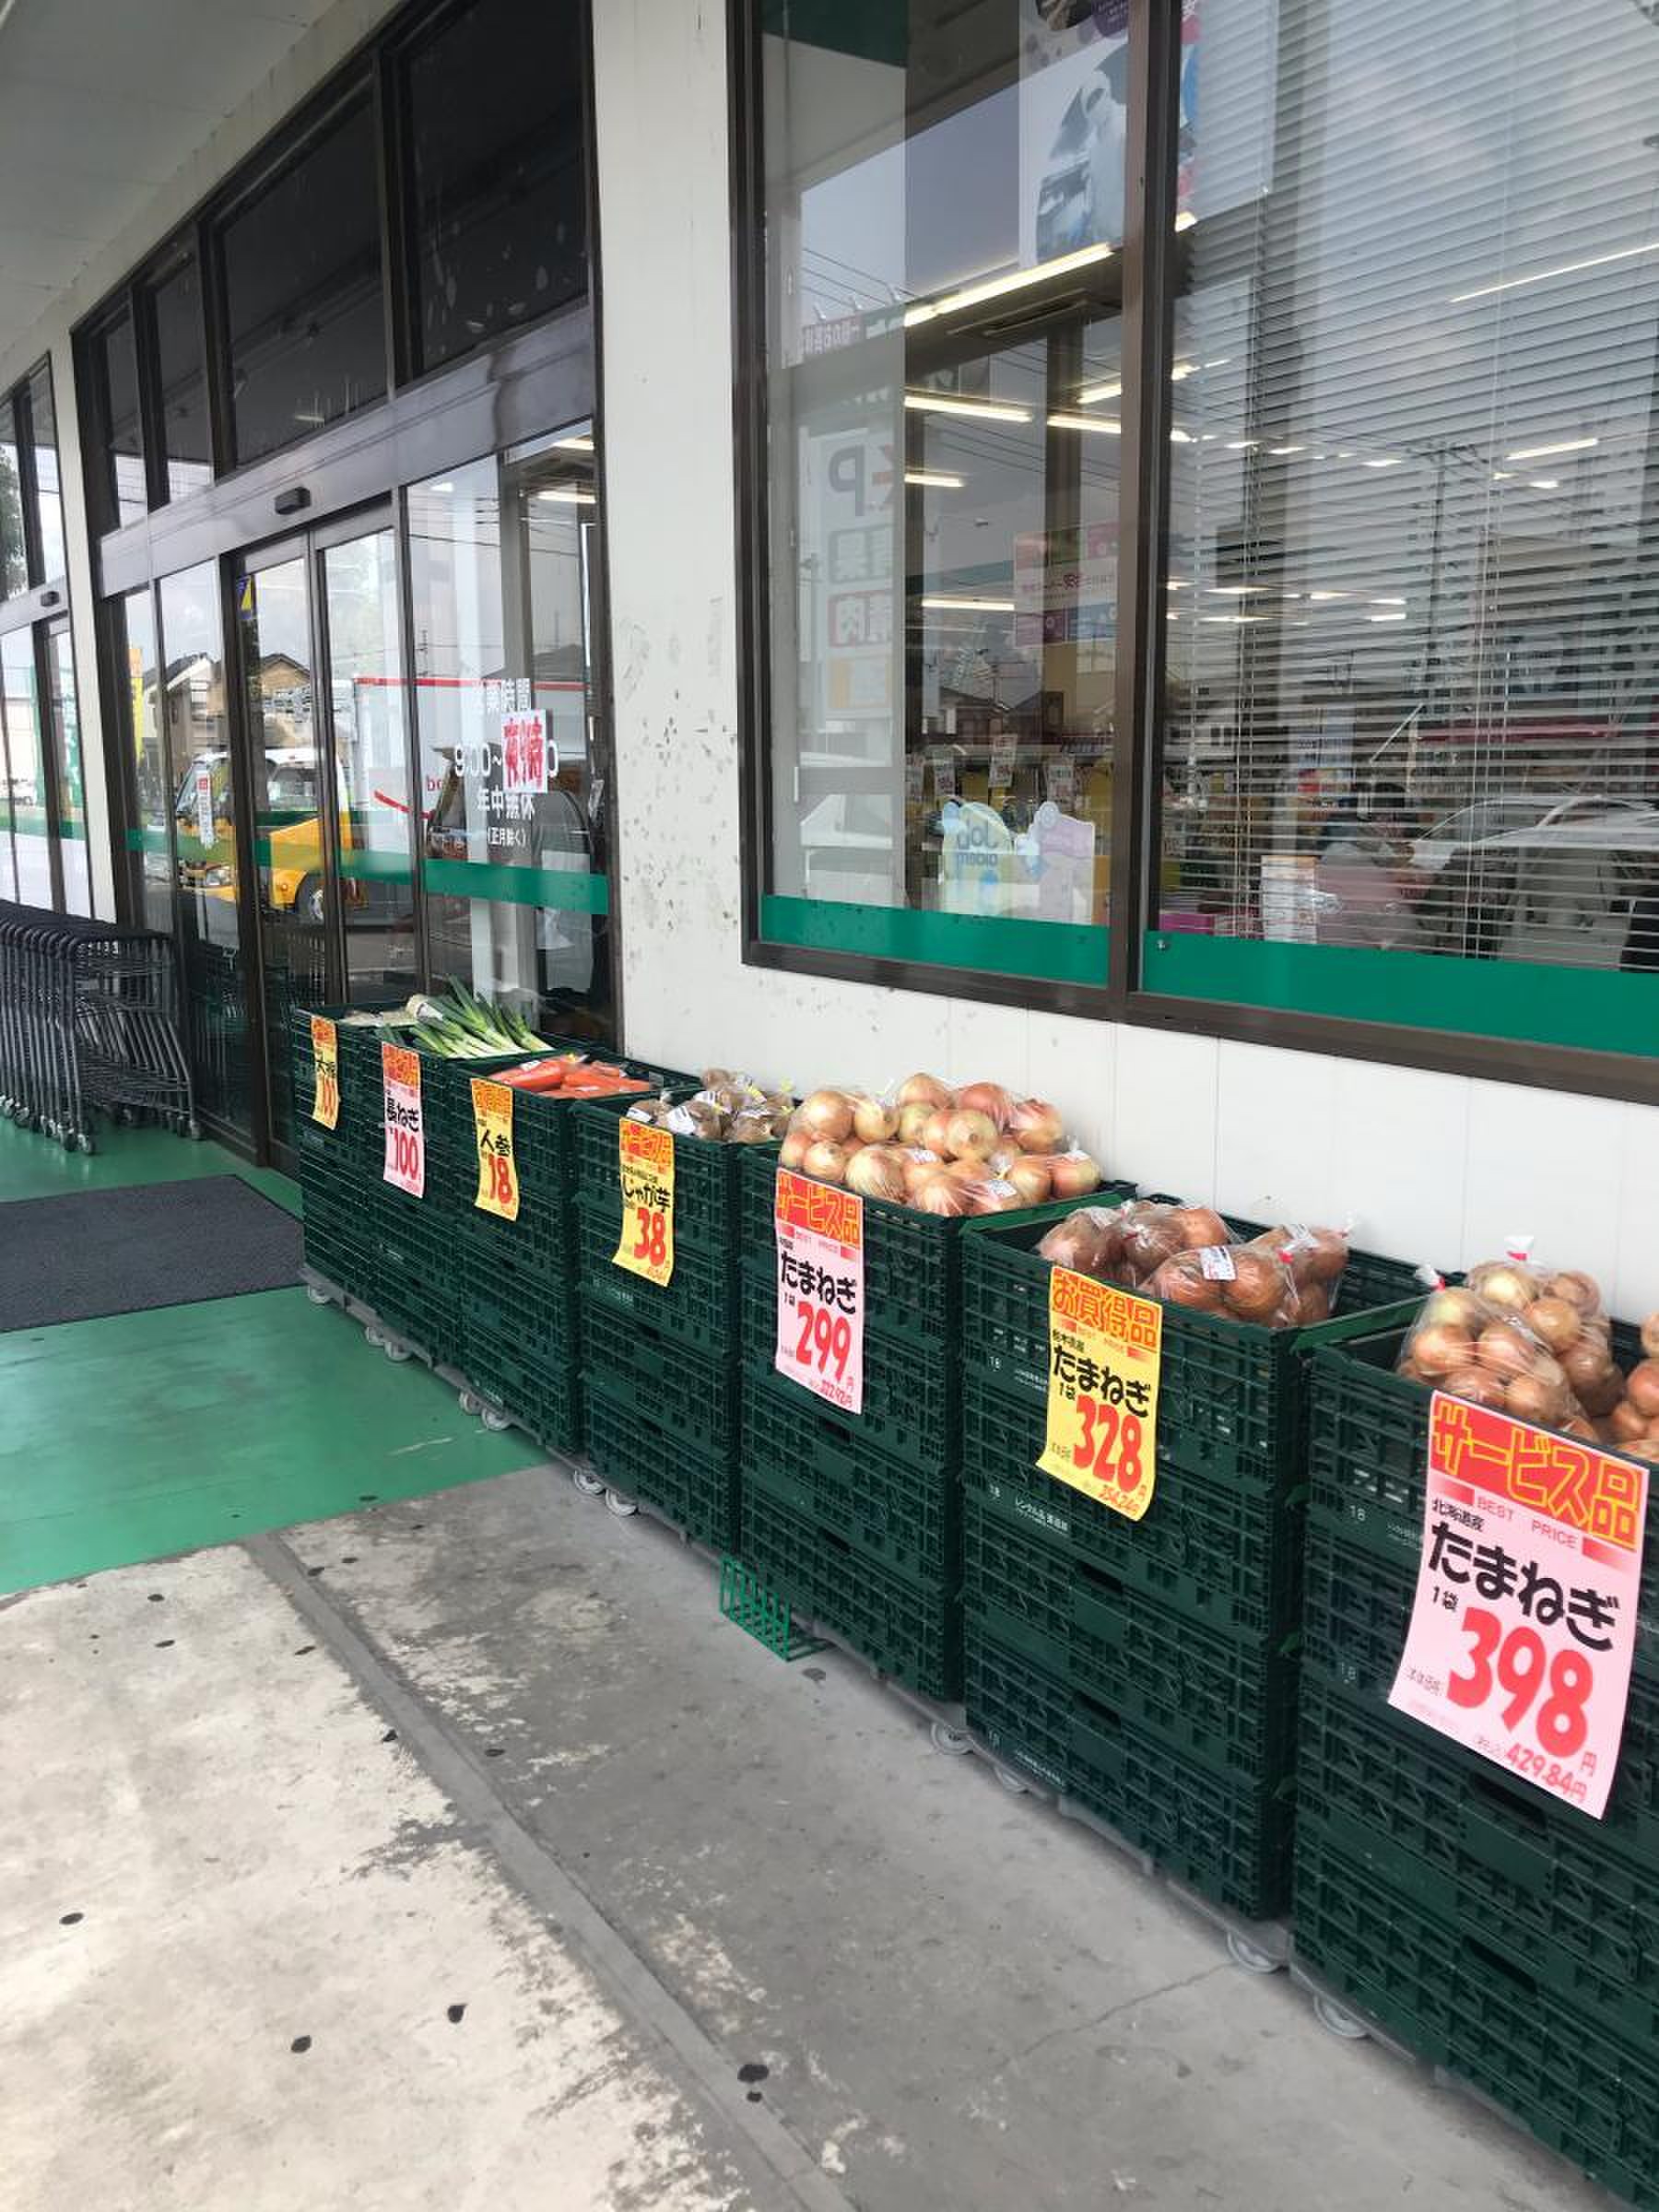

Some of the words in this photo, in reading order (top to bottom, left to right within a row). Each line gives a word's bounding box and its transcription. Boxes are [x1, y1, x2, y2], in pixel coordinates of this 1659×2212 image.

[394, 1127, 418, 1180] 100
[488, 1153, 513, 1204] 18
[634, 1207, 666, 1266] 38
[778, 1173, 861, 1249] サービス品
[781, 1251, 856, 1314] たまねぎ
[1053, 1272, 1158, 1348] お買得品
[796, 1300, 851, 1382] 299
[1053, 1346, 1151, 1418] たまねぎ
[1073, 1394, 1142, 1491] 328
[1432, 1400, 1641, 1546] サービス品
[1477, 1496, 1514, 1521] BEST
[1531, 1519, 1578, 1549] PRICE
[1428, 1522, 1620, 1652] たまねぎ
[1446, 1607, 1594, 1758] 398
[1580, 1750, 1598, 1777] 円
[1504, 1743, 1588, 1804] 429.84円
